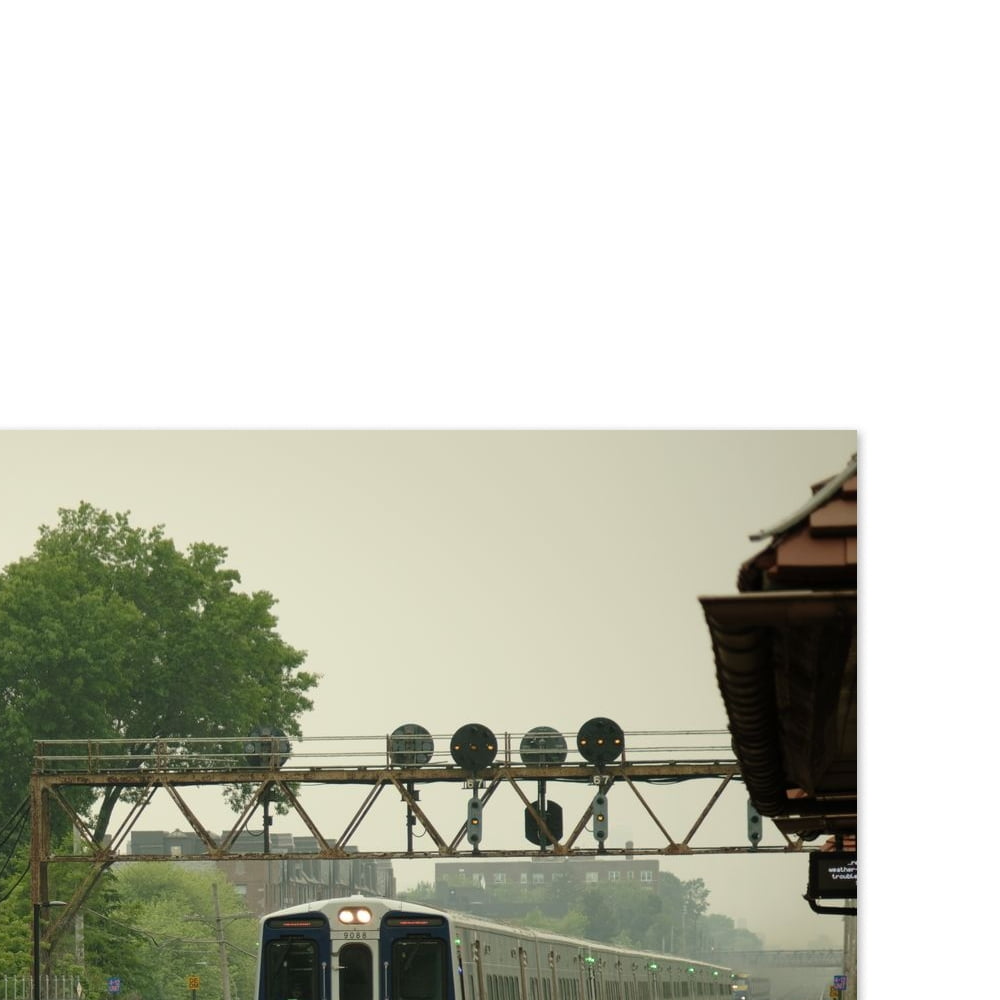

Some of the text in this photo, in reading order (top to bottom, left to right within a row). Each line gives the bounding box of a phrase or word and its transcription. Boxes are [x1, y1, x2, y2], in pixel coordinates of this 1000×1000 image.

[466, 778, 482, 788] 67
[593, 775, 609, 785] 67
[343, 931, 367, 939] 9088
